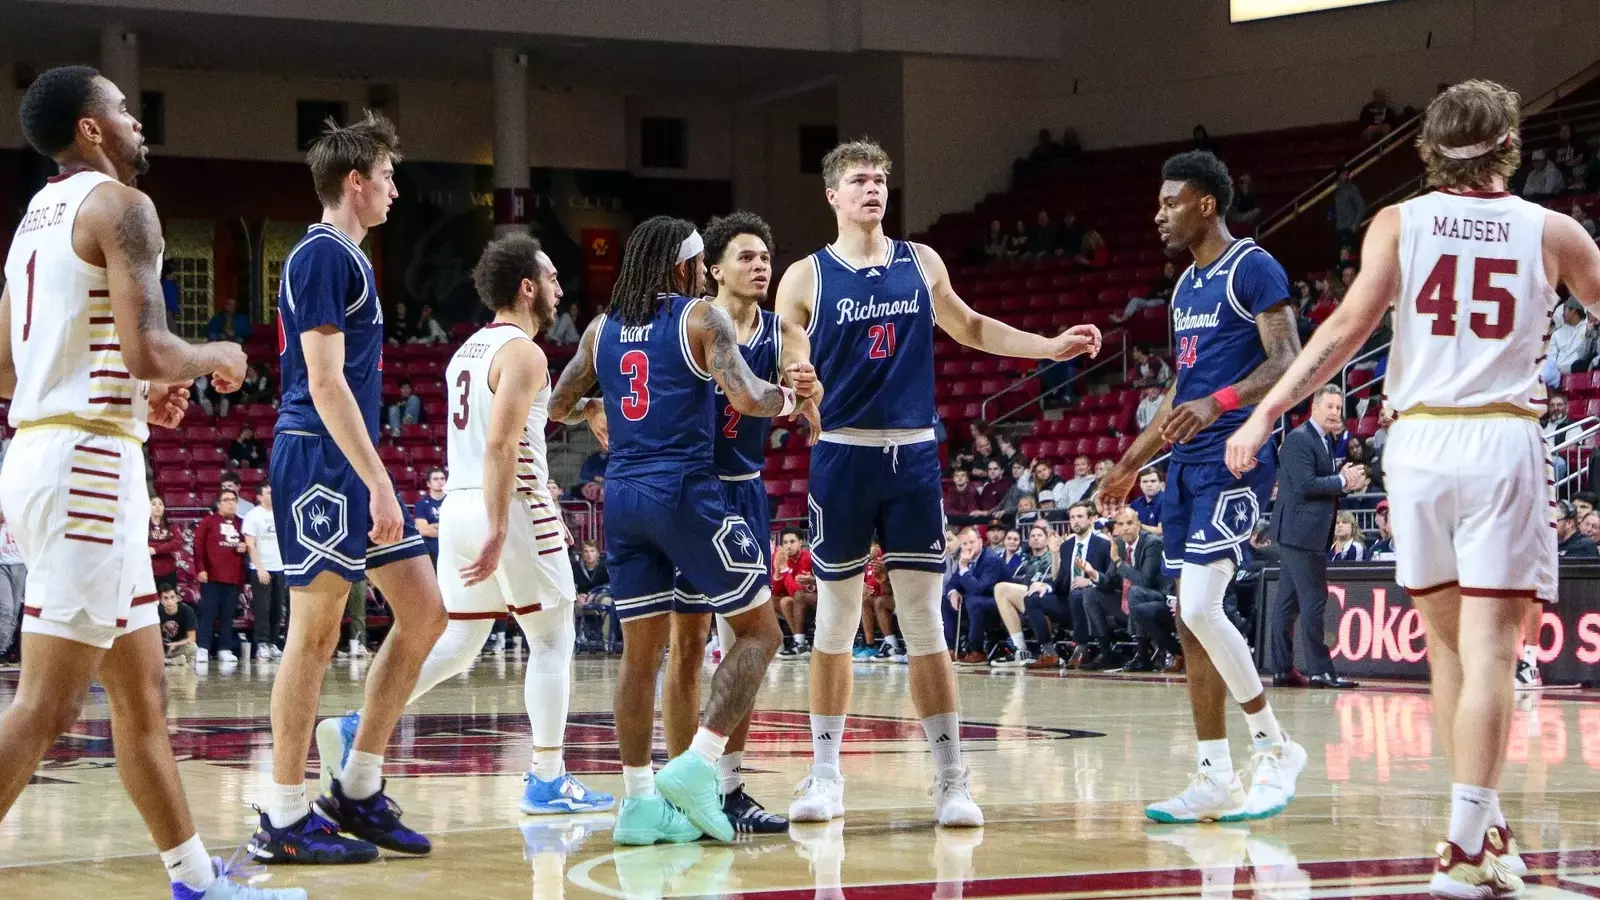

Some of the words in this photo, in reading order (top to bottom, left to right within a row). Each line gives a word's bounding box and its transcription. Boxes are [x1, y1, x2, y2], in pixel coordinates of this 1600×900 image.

[1432, 216, 1511, 243] MADSEN
[22, 250, 38, 342] 1
[836, 289, 920, 325] Richmond
[1415, 253, 1520, 340] 45
[619, 322, 654, 343] HUNT
[1173, 302, 1222, 333] Richmond
[868, 322, 896, 359] 21
[1177, 335, 1198, 369] 24
[452, 369, 471, 431] 3
[619, 350, 650, 421] 3
[721, 403, 742, 439] 2
